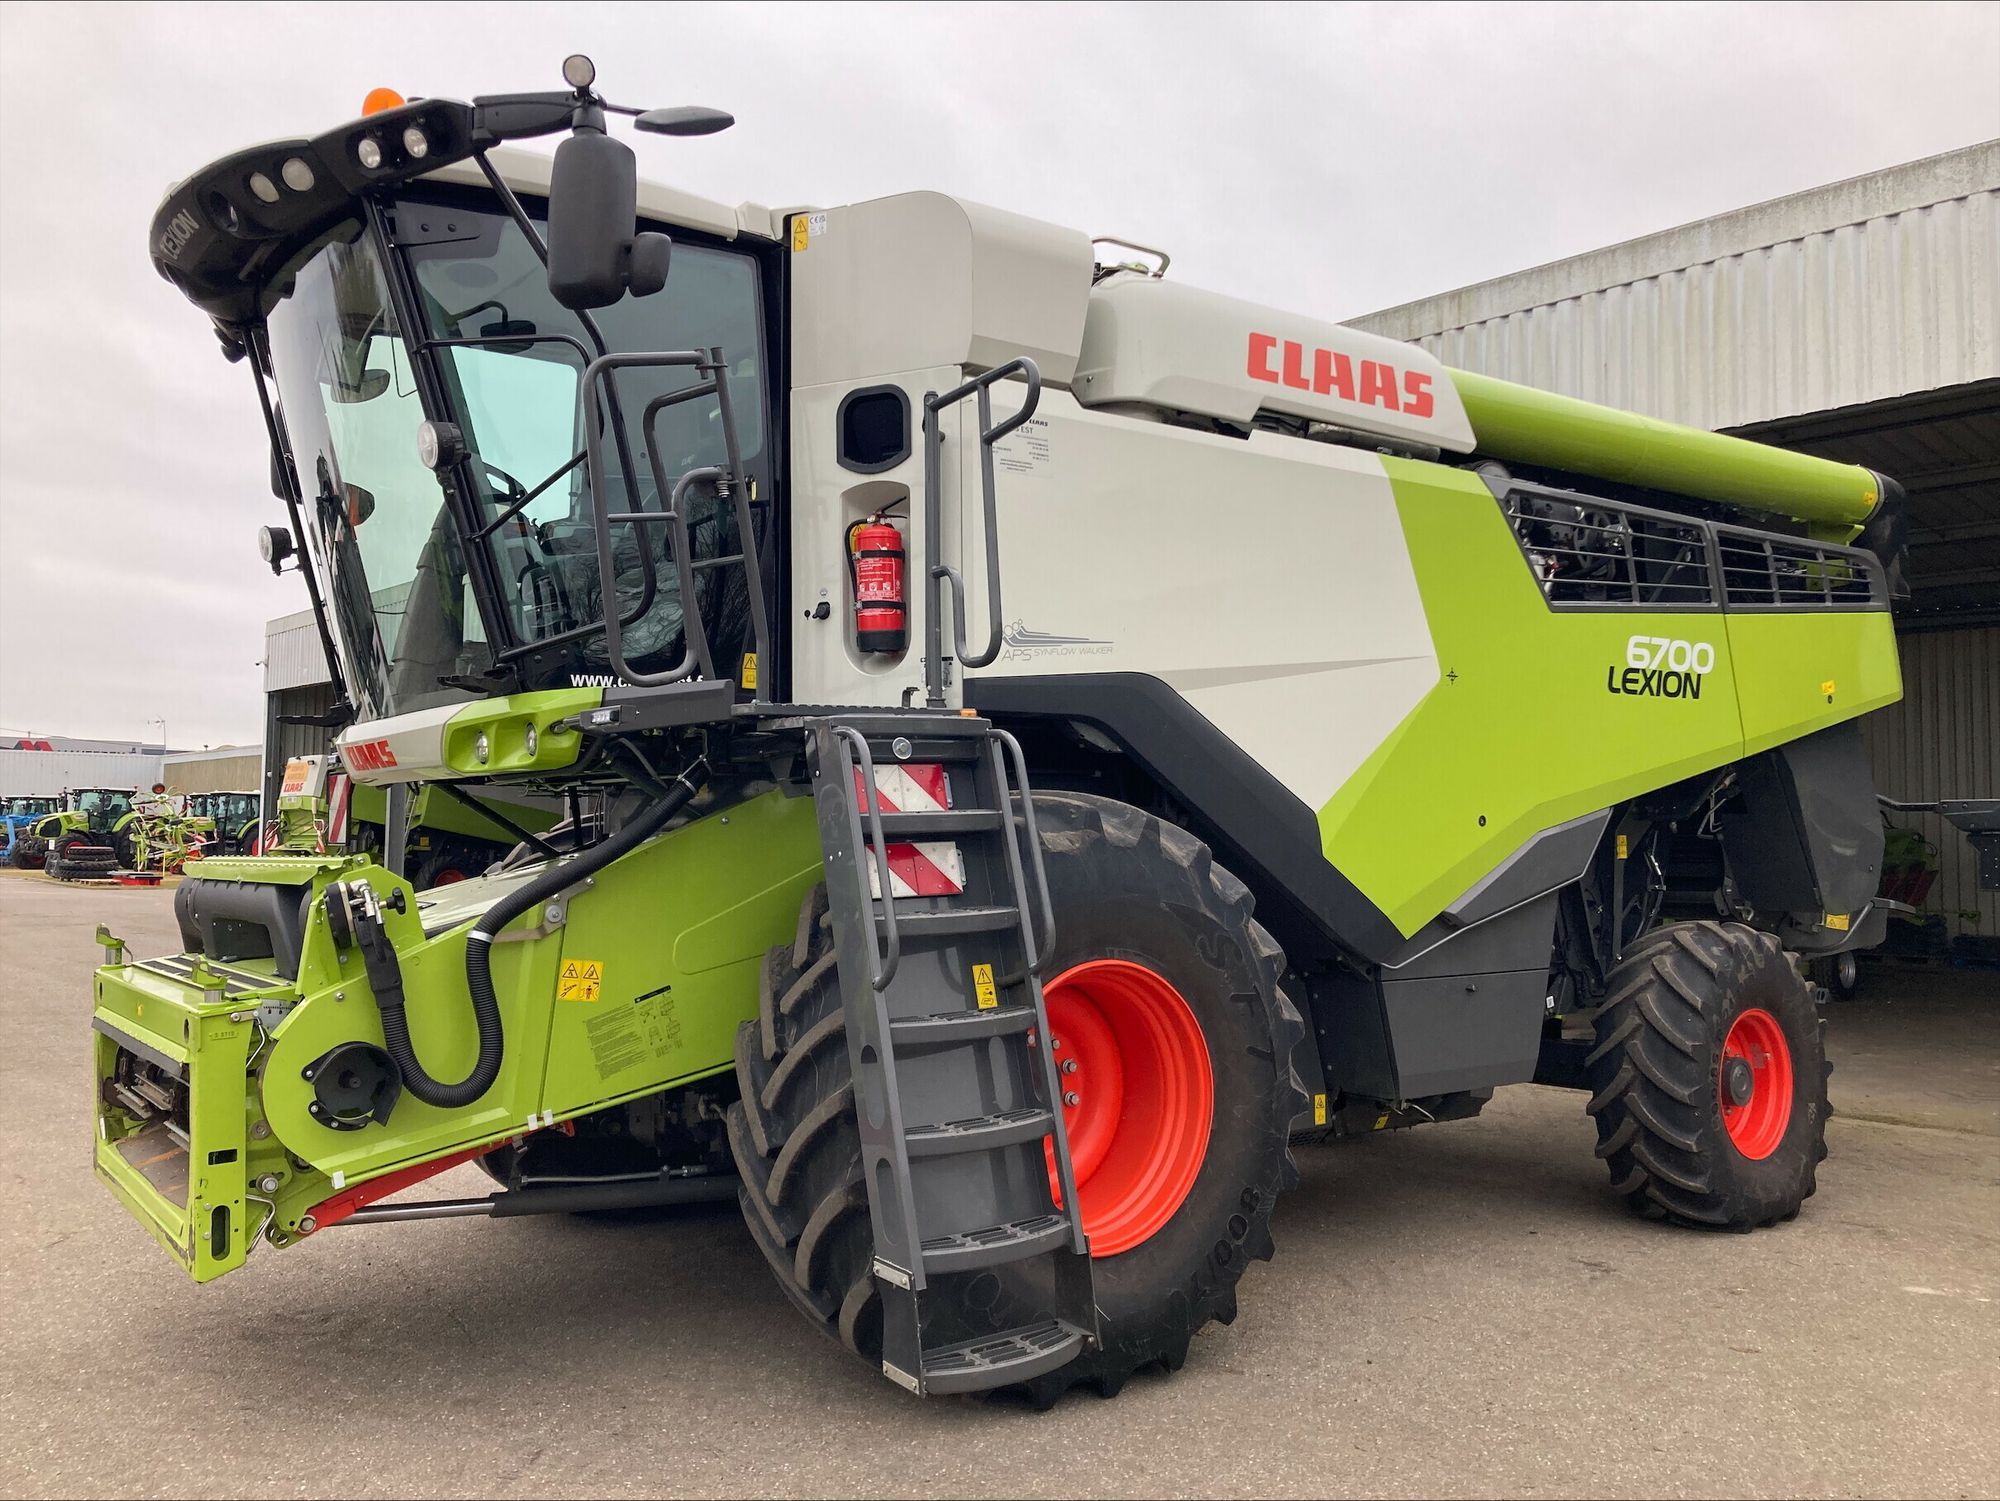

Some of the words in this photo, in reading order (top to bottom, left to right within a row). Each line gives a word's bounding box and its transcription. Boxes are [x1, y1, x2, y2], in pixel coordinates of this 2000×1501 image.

[160, 207, 200, 260] LEXION
[1247, 332, 1434, 419] CLAAS
[1029, 418, 1048, 427] CLAAS
[1001, 648, 1032, 661] APS
[1034, 647, 1077, 657] SYNFLOW
[1079, 646, 1113, 655] WALKER
[1626, 635, 1715, 674] 6700
[1608, 666, 1702, 699] LEXION
[345, 740, 398, 772] CLAAS
[283, 782, 304, 793] CLAAS
